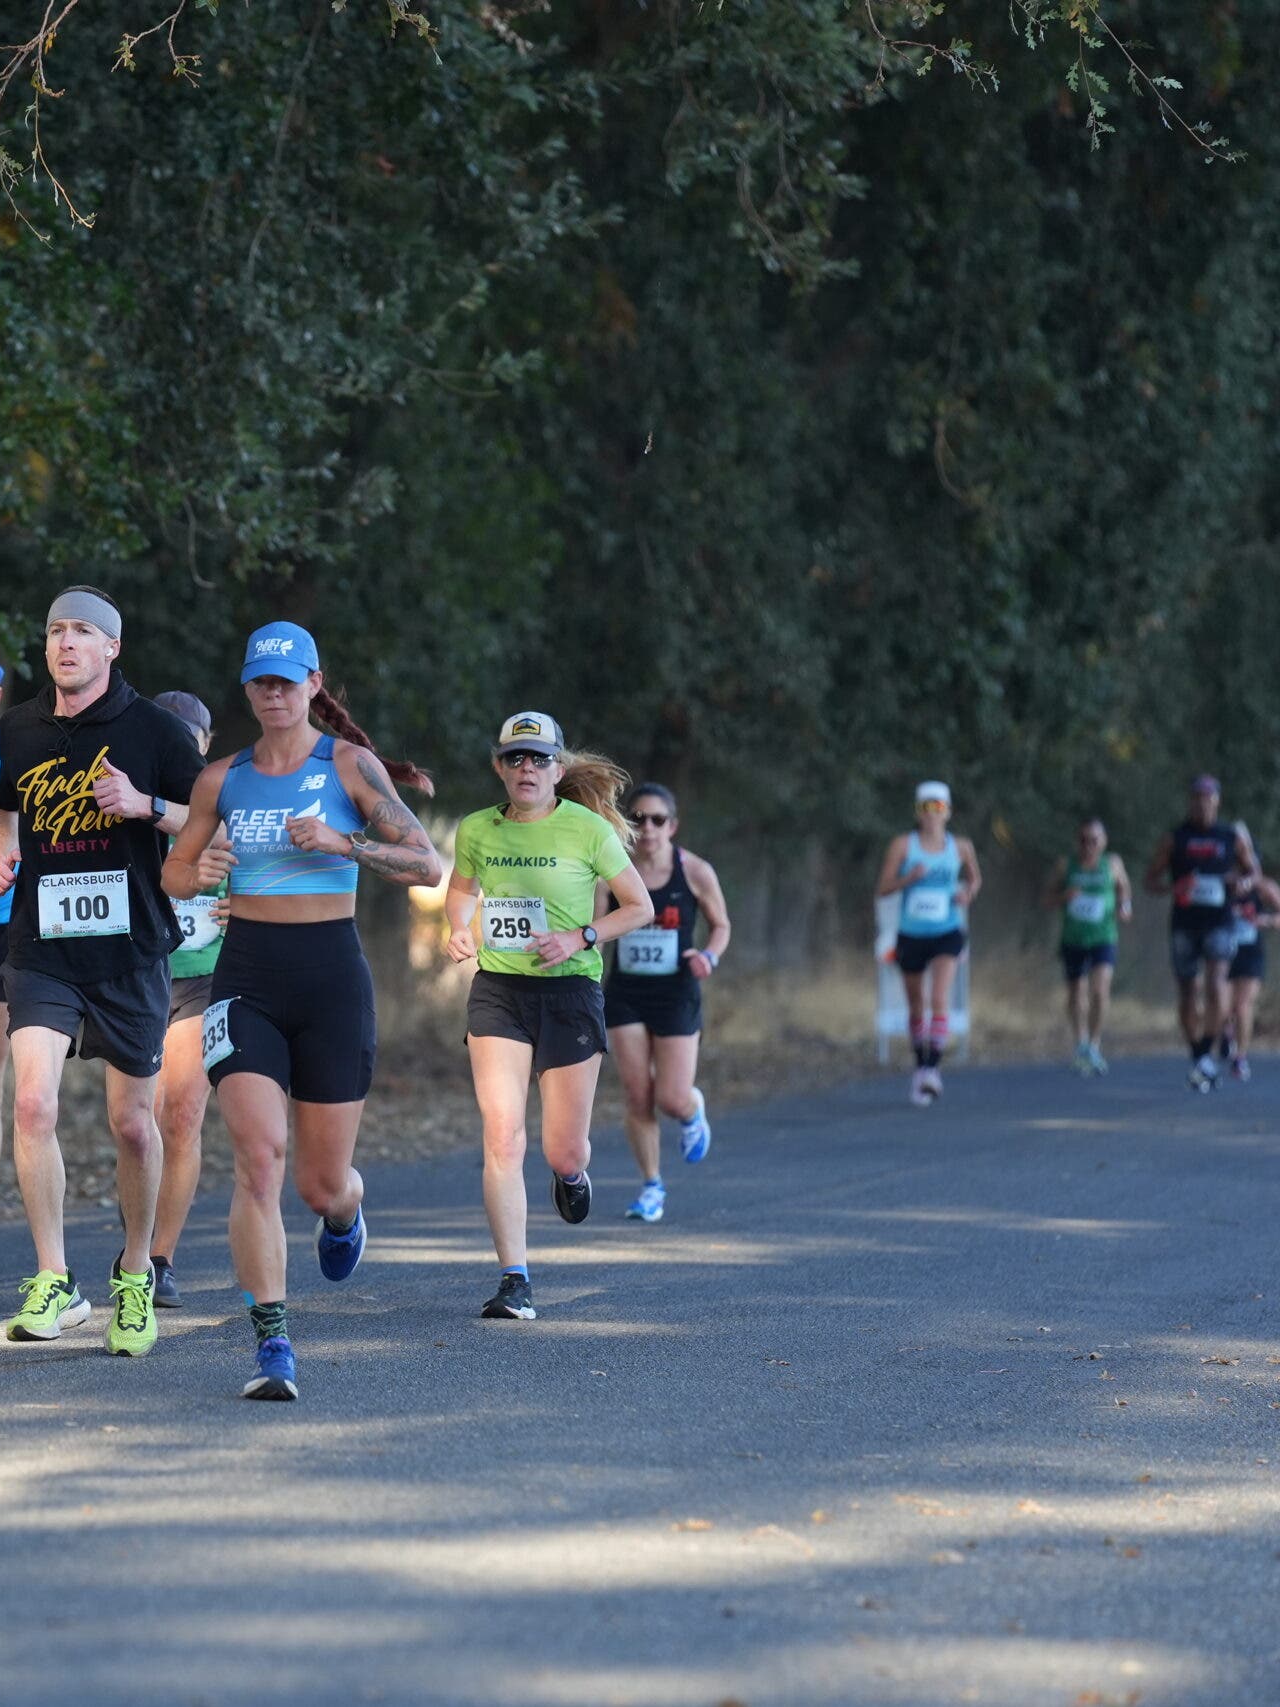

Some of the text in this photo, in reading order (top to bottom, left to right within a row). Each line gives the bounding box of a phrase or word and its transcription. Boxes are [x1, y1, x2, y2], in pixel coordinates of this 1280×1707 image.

[17, 746, 112, 813] Track
[32, 806, 48, 832] &
[229, 808, 294, 826] FLEET
[231, 825, 286, 843] FEET
[41, 839, 111, 854] LIBERTY
[231, 844, 294, 854] CING TEAM
[485, 856, 557, 868] PAMAKIDS
[41, 873, 124, 888] CLARKSBURG
[58, 895, 110, 921] 100
[481, 900, 541, 909] LARKSBURG
[490, 917, 532, 939] 259
[629, 946, 664, 963] 332
